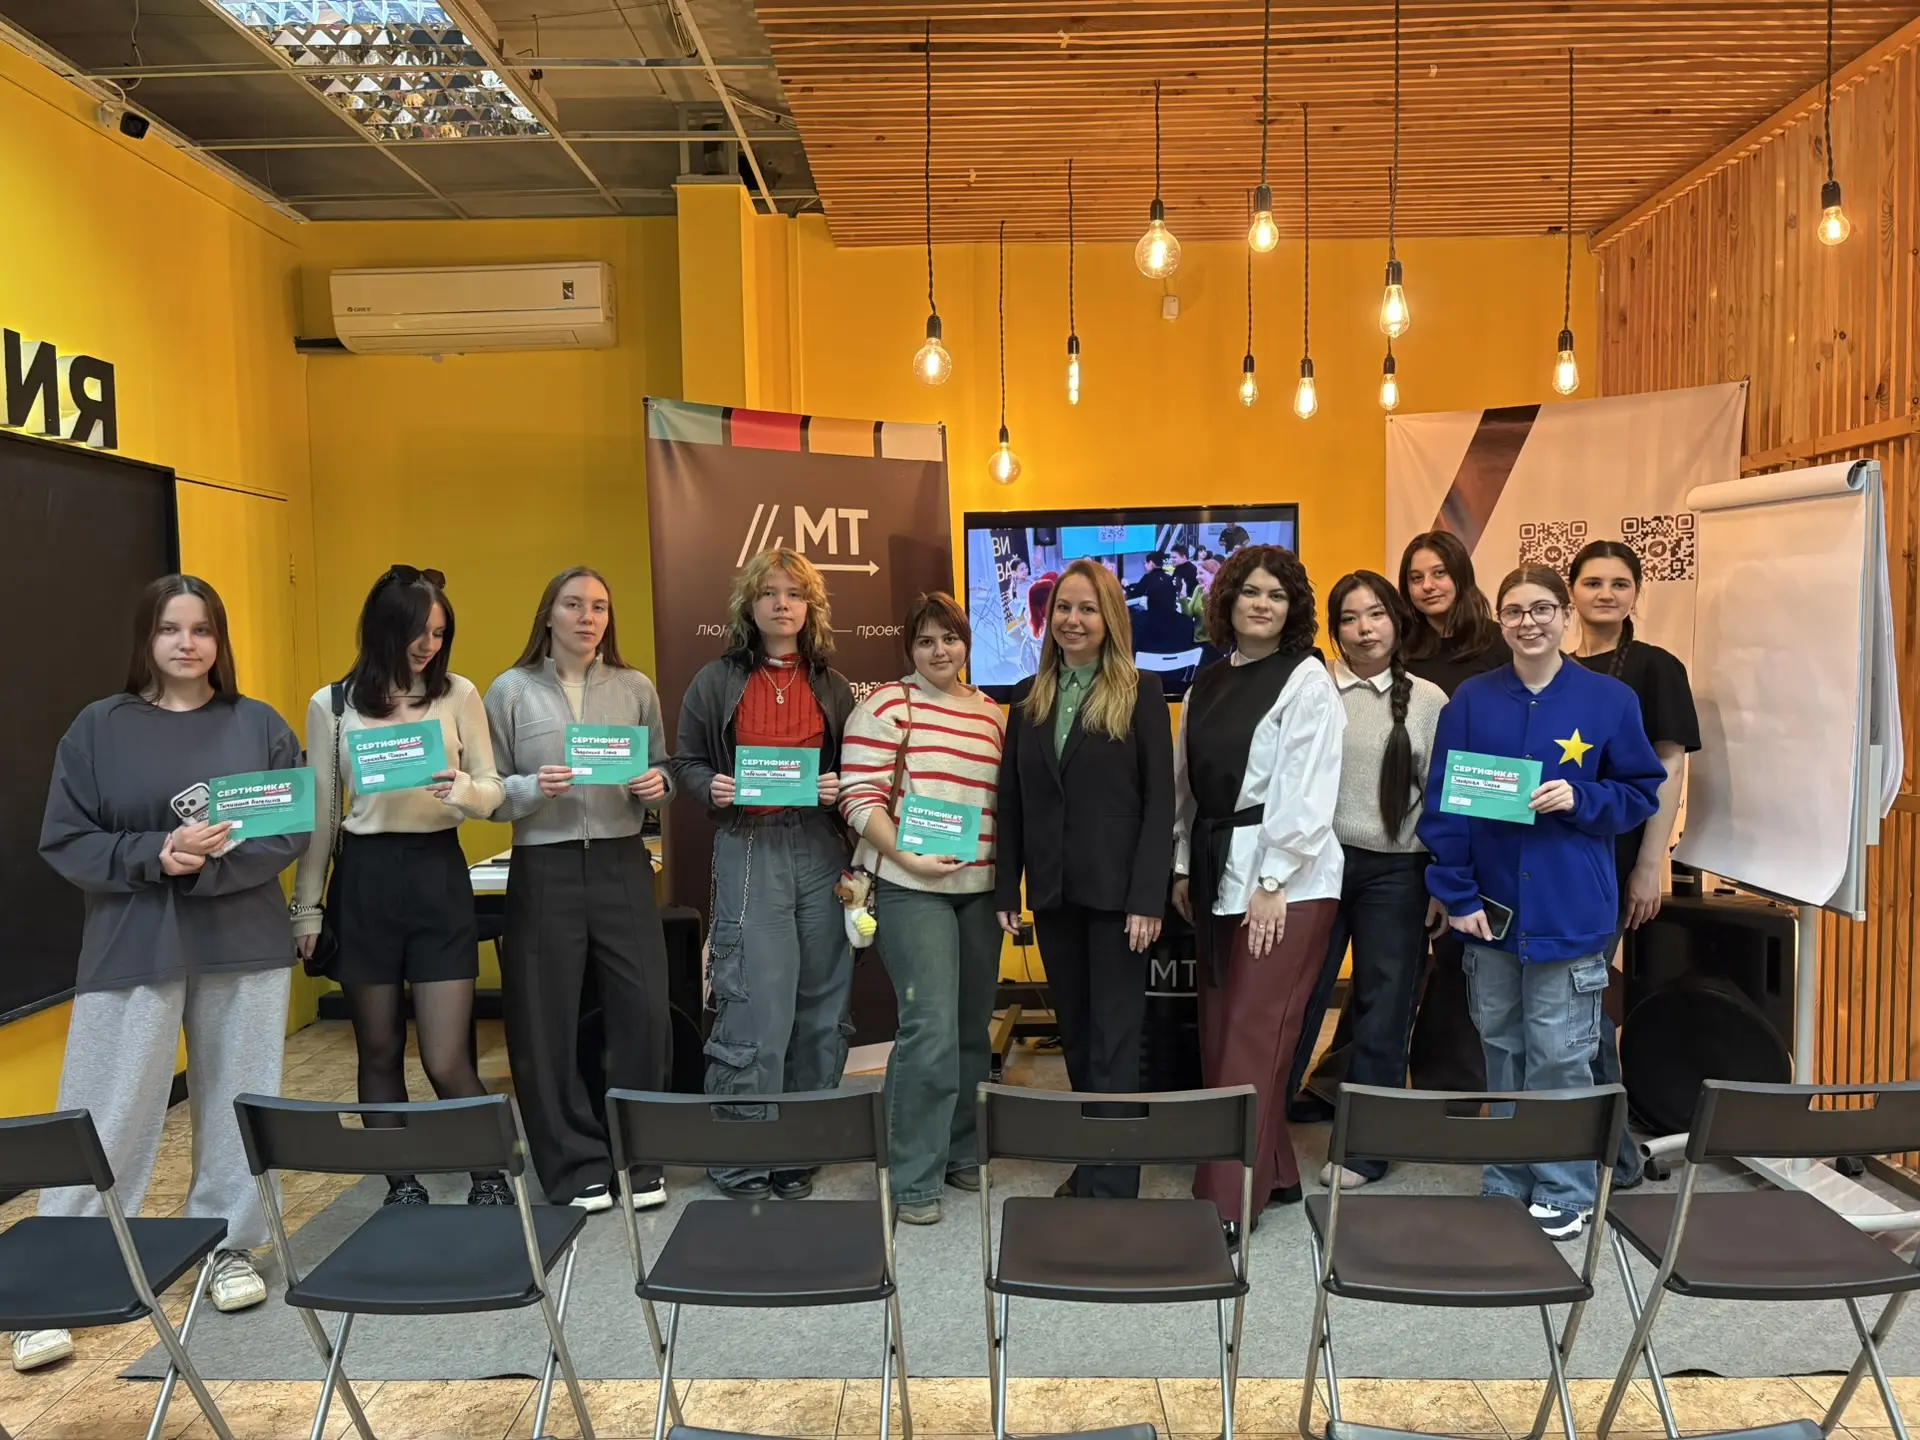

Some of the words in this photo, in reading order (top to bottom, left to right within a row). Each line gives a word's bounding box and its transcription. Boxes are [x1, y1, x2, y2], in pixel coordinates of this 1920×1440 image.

[856, 624, 904, 639] проек
[356, 736, 422, 751] СЕРТИФИКАТ
[571, 737, 630, 745] СЕРТИФИКАТ
[741, 759, 801, 767] СЕРТИФИКАТ
[1453, 764, 1519, 779] СЕРТИФИКАТ
[216, 782, 292, 798] СЕРТИФИКАТ
[908, 806, 963, 820] СЕРТИФИКАТ
